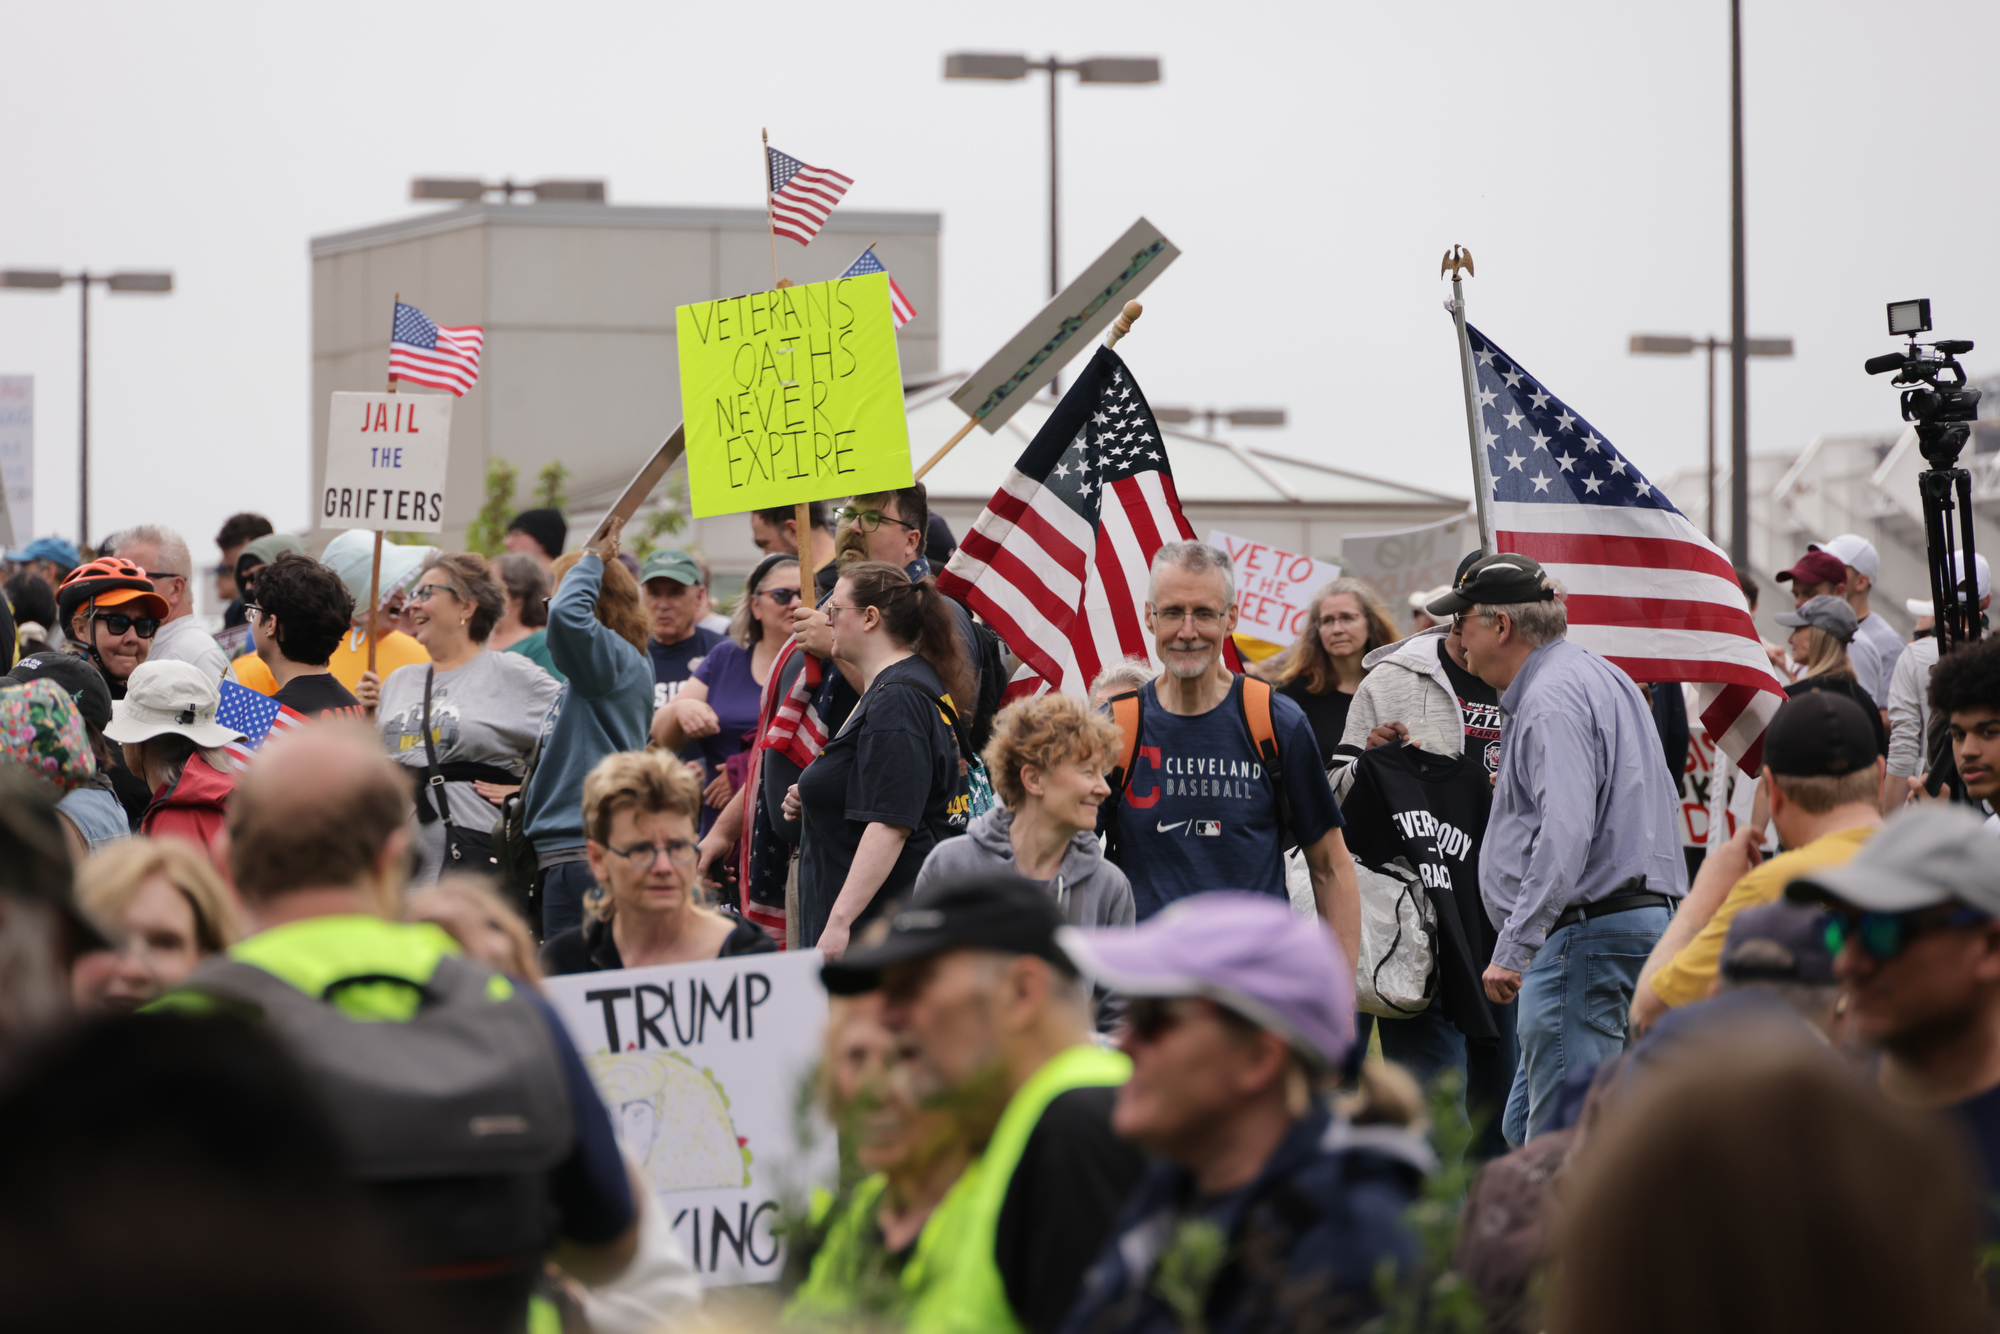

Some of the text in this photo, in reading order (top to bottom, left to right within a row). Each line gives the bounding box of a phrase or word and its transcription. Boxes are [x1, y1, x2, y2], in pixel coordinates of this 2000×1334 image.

[689, 278, 855, 345] VETERANS
[733, 329, 857, 391] OATHS
[360, 402, 419, 433] JAIL
[716, 380, 835, 437] NEVER
[371, 447, 403, 468] THE
[726, 430, 856, 489] EXPIRE
[324, 487, 443, 522] GRIFTERS
[1243, 571, 1289, 599] THE
[1125, 745, 1162, 809] C
[1166, 757, 1262, 780] CLEVELAND
[1166, 779, 1252, 799] BASEBALL
[585, 973, 771, 1054] TRUMP
[672, 1201, 787, 1274] ING
